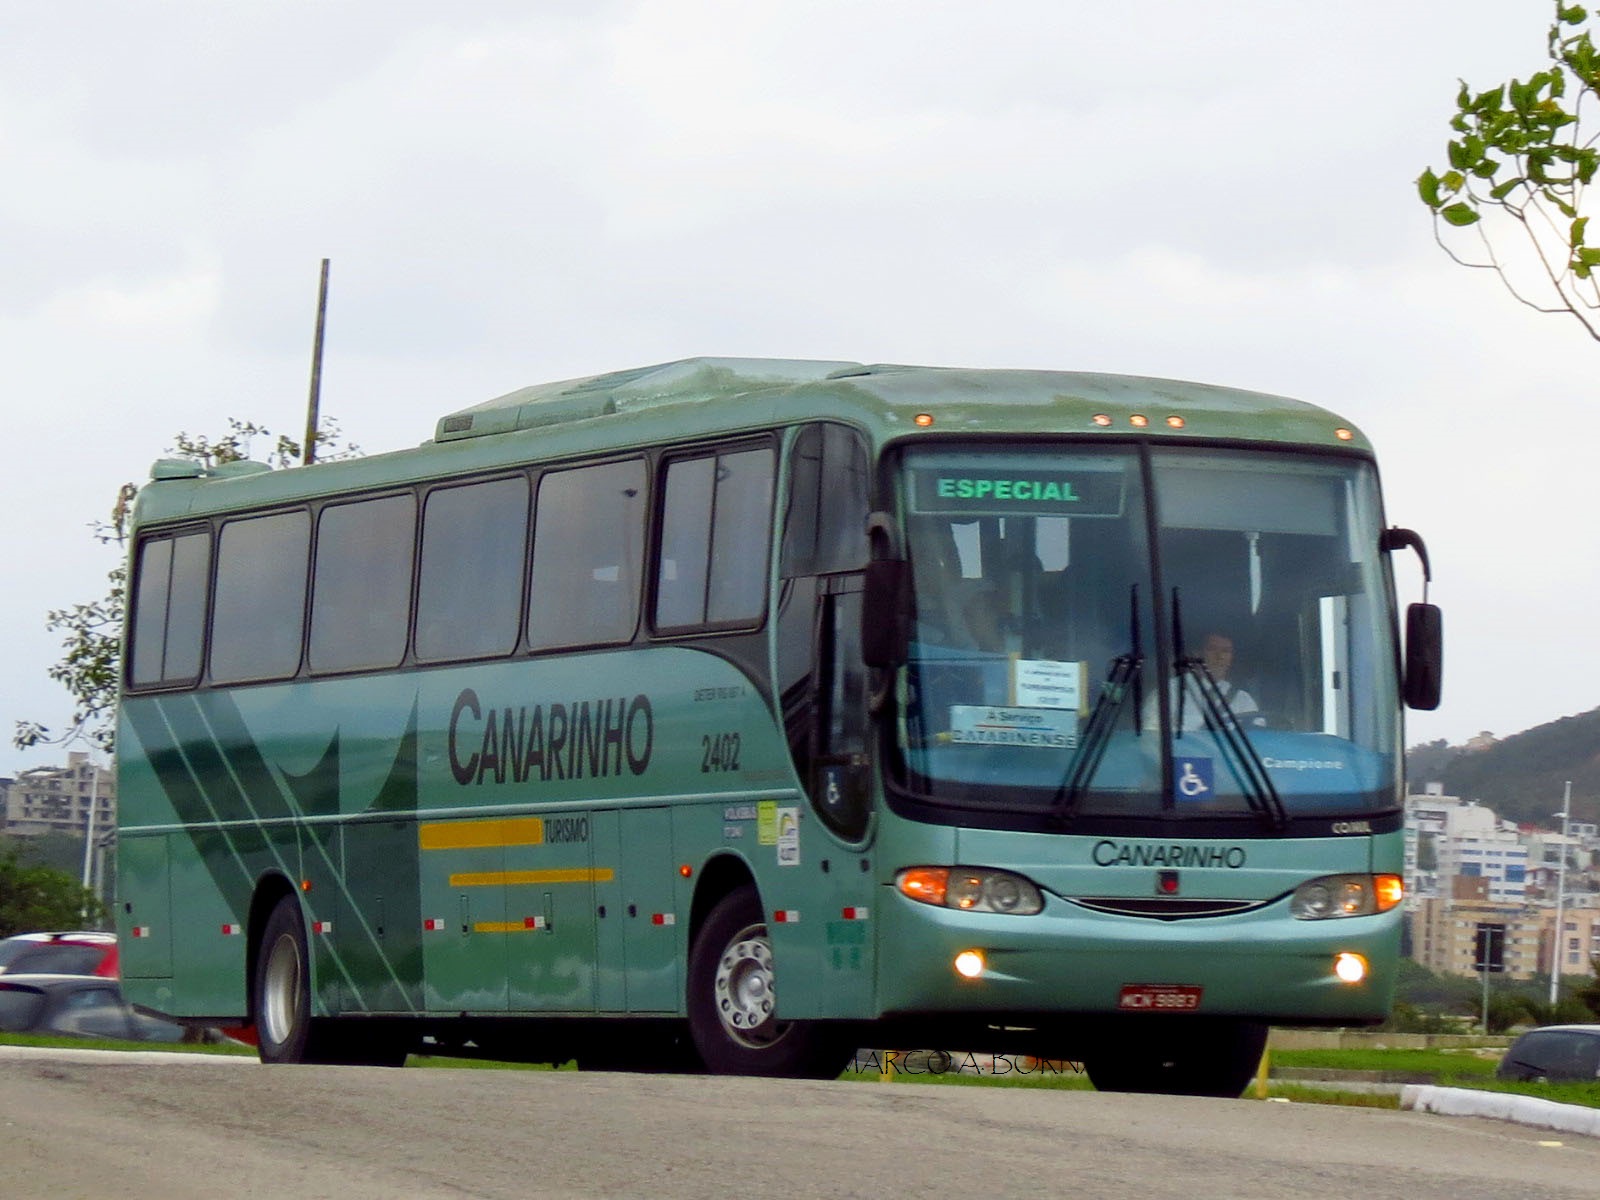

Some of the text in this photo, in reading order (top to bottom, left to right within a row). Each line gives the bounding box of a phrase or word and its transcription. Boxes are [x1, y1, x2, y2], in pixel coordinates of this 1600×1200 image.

[937, 478, 1080, 502] ESPECIAL
[448, 688, 654, 785] CANARINHO
[701, 732, 741, 773] 2402
[1262, 757, 1344, 771] Campione
[543, 818, 590, 844] TURISMO
[1092, 839, 1246, 869] CANARINHO
